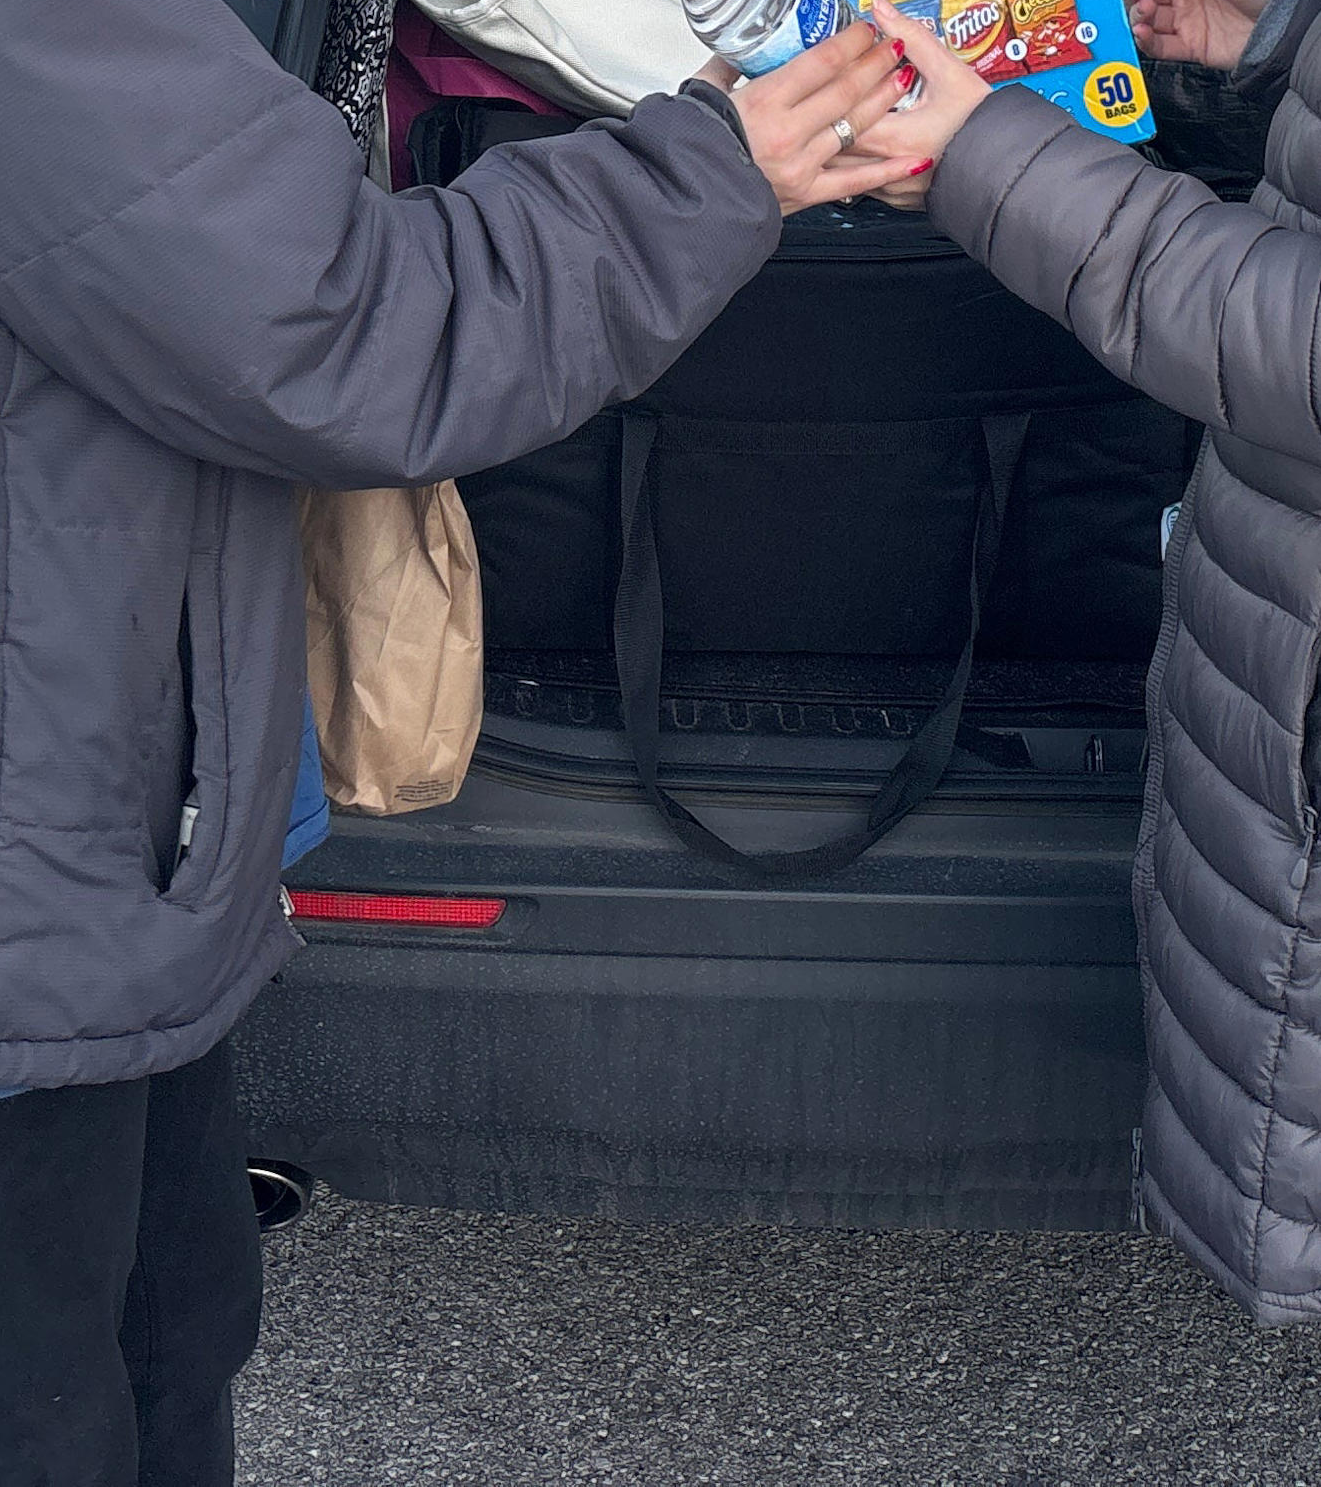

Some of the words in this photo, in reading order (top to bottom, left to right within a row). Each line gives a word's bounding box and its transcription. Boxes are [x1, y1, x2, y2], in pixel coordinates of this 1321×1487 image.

[945, 1, 1000, 50] Fritos
[1081, 25, 1093, 40] 16
[1096, 72, 1133, 107] 50
[1105, 103, 1137, 120] BAGS
